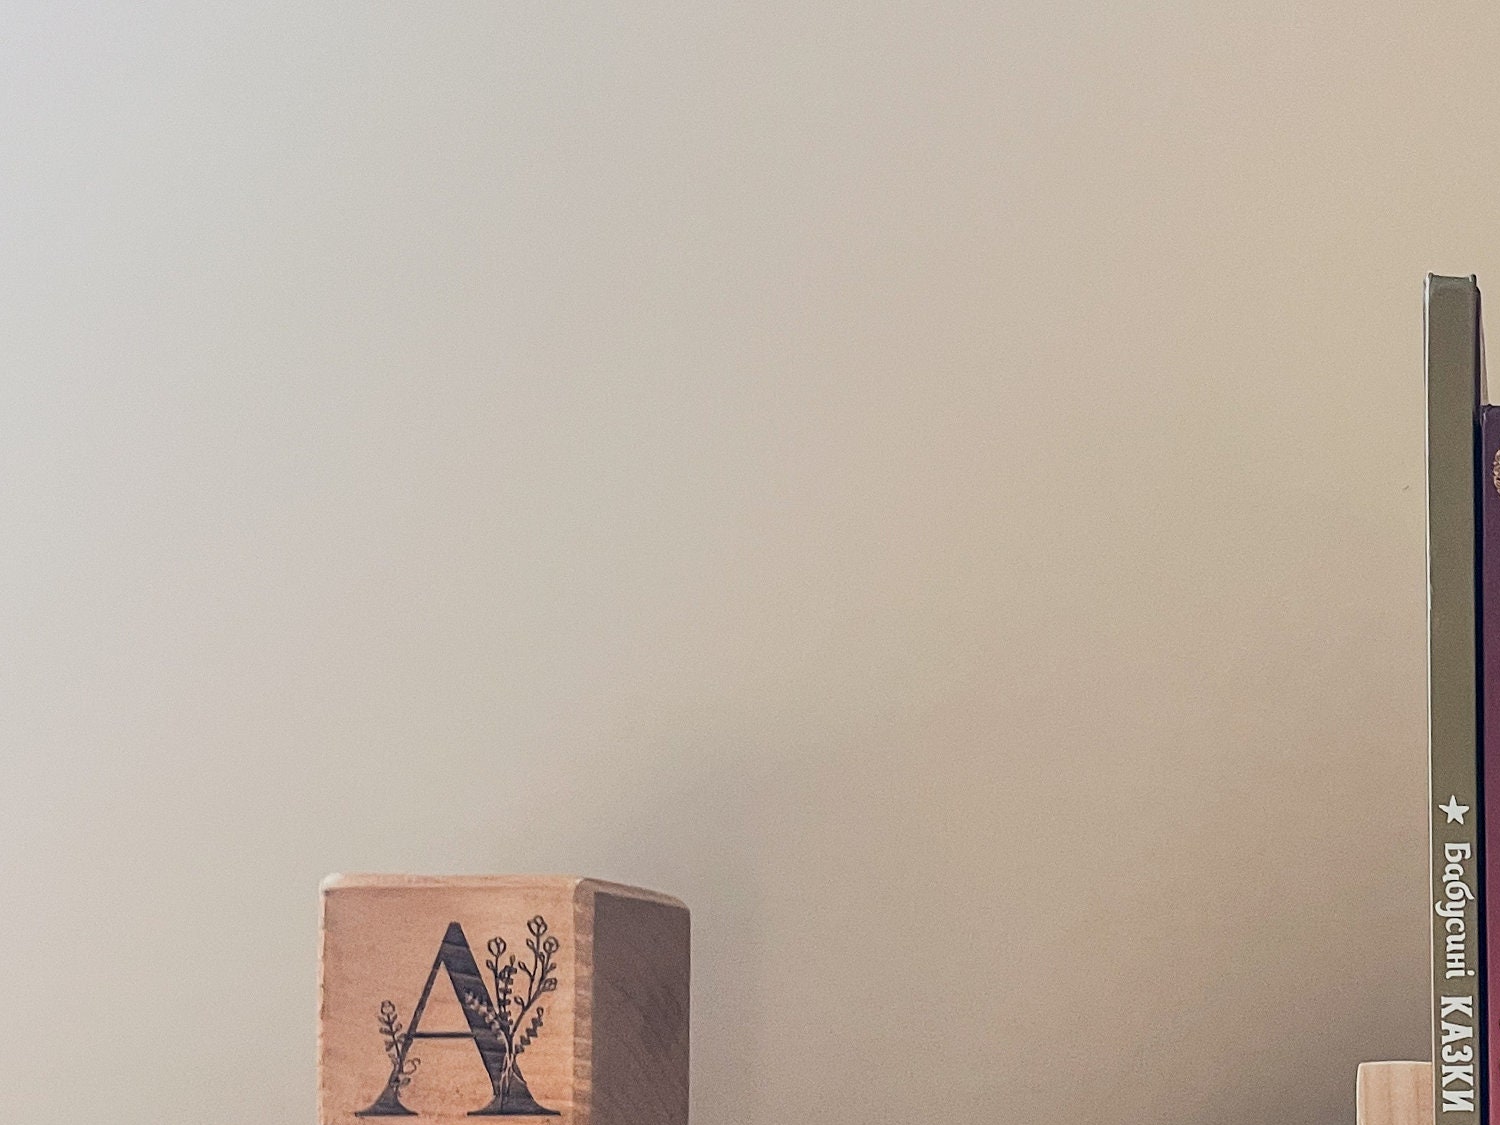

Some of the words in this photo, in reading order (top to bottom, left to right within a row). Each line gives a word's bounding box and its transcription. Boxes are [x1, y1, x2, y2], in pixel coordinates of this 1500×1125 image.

[1434, 842, 1475, 980] Бабусині
[354, 915, 562, 1117] A
[1440, 994, 1474, 1113] КАЗКИ
